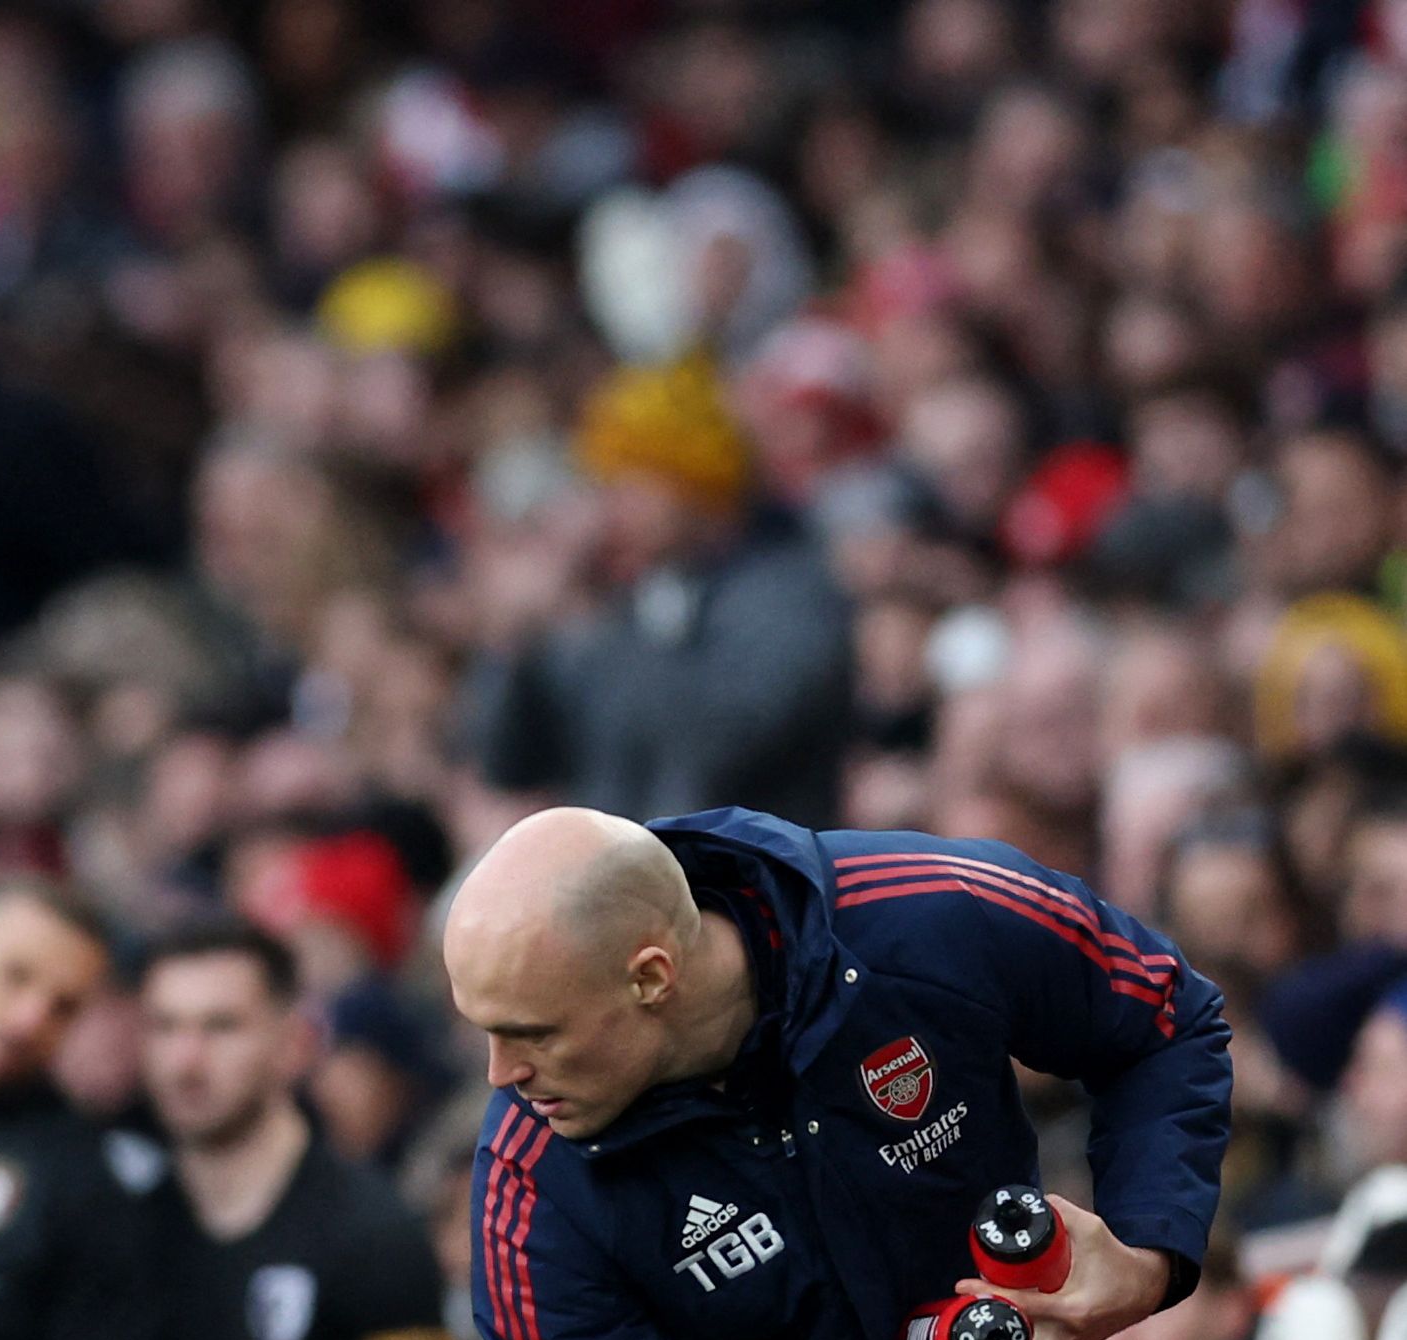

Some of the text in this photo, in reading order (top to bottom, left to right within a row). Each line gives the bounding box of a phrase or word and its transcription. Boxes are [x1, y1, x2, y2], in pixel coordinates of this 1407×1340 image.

[867, 1046, 920, 1084] Arsenal
[878, 1101, 968, 1167] Emirates
[900, 1125, 962, 1175] FLY BETTER
[681, 1203, 739, 1249] adidas
[673, 1212, 785, 1292] TGB
